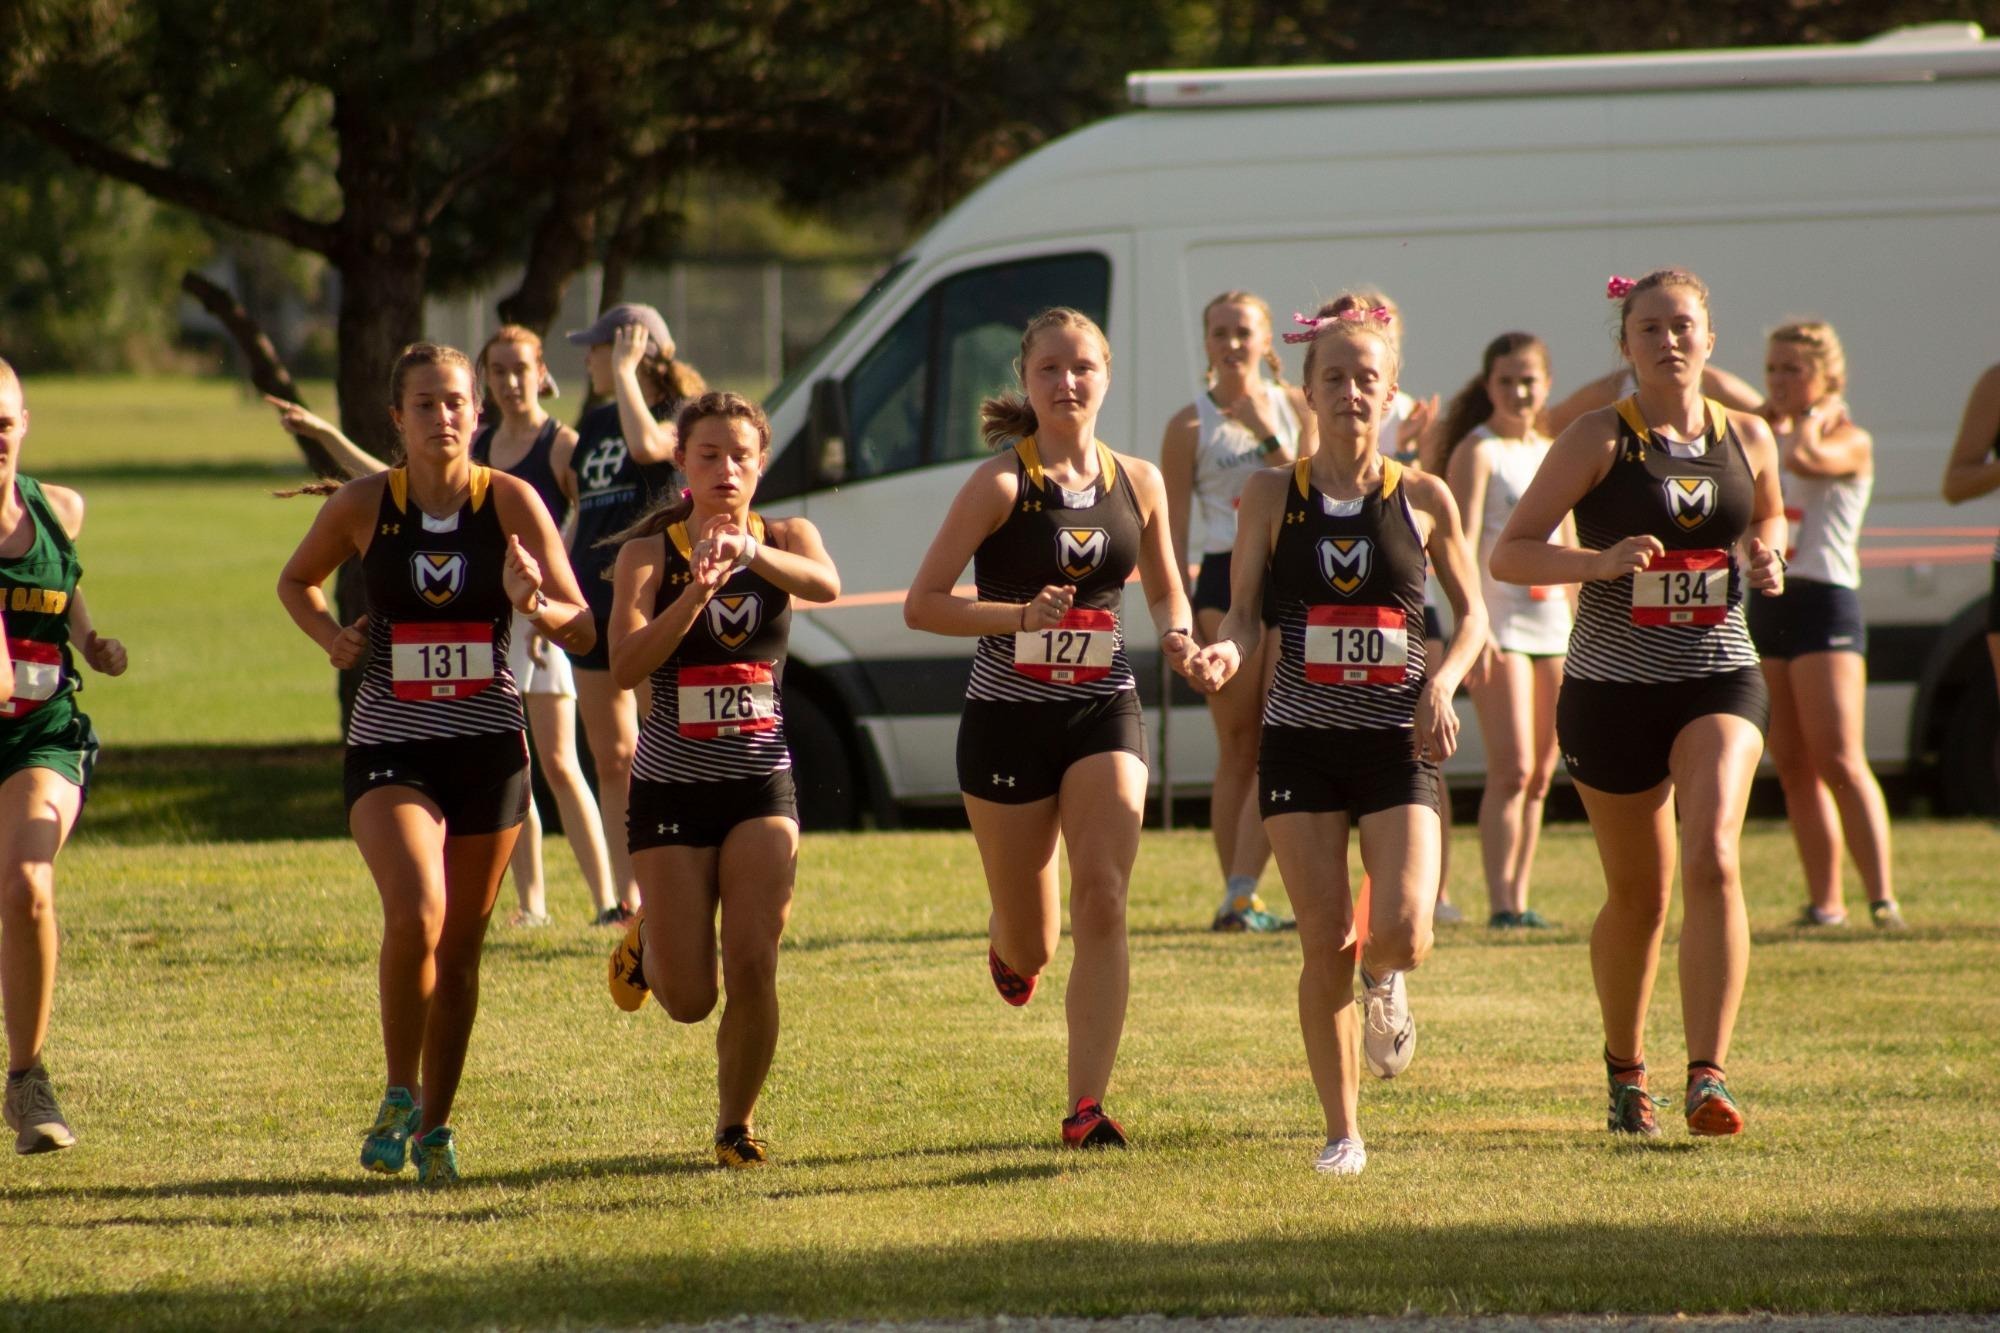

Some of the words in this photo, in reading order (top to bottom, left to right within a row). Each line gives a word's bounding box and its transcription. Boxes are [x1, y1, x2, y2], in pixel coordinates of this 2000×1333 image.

[1667, 479, 1713, 516] M
[1059, 530, 1105, 567] M
[1320, 539, 1370, 579] M
[414, 554, 462, 591] M
[1659, 572, 1709, 605] 134
[707, 596, 758, 637] M
[418, 644, 468, 678] 131
[1041, 631, 1092, 664] 127
[1332, 628, 1384, 663] 130
[704, 685, 753, 720] 126
